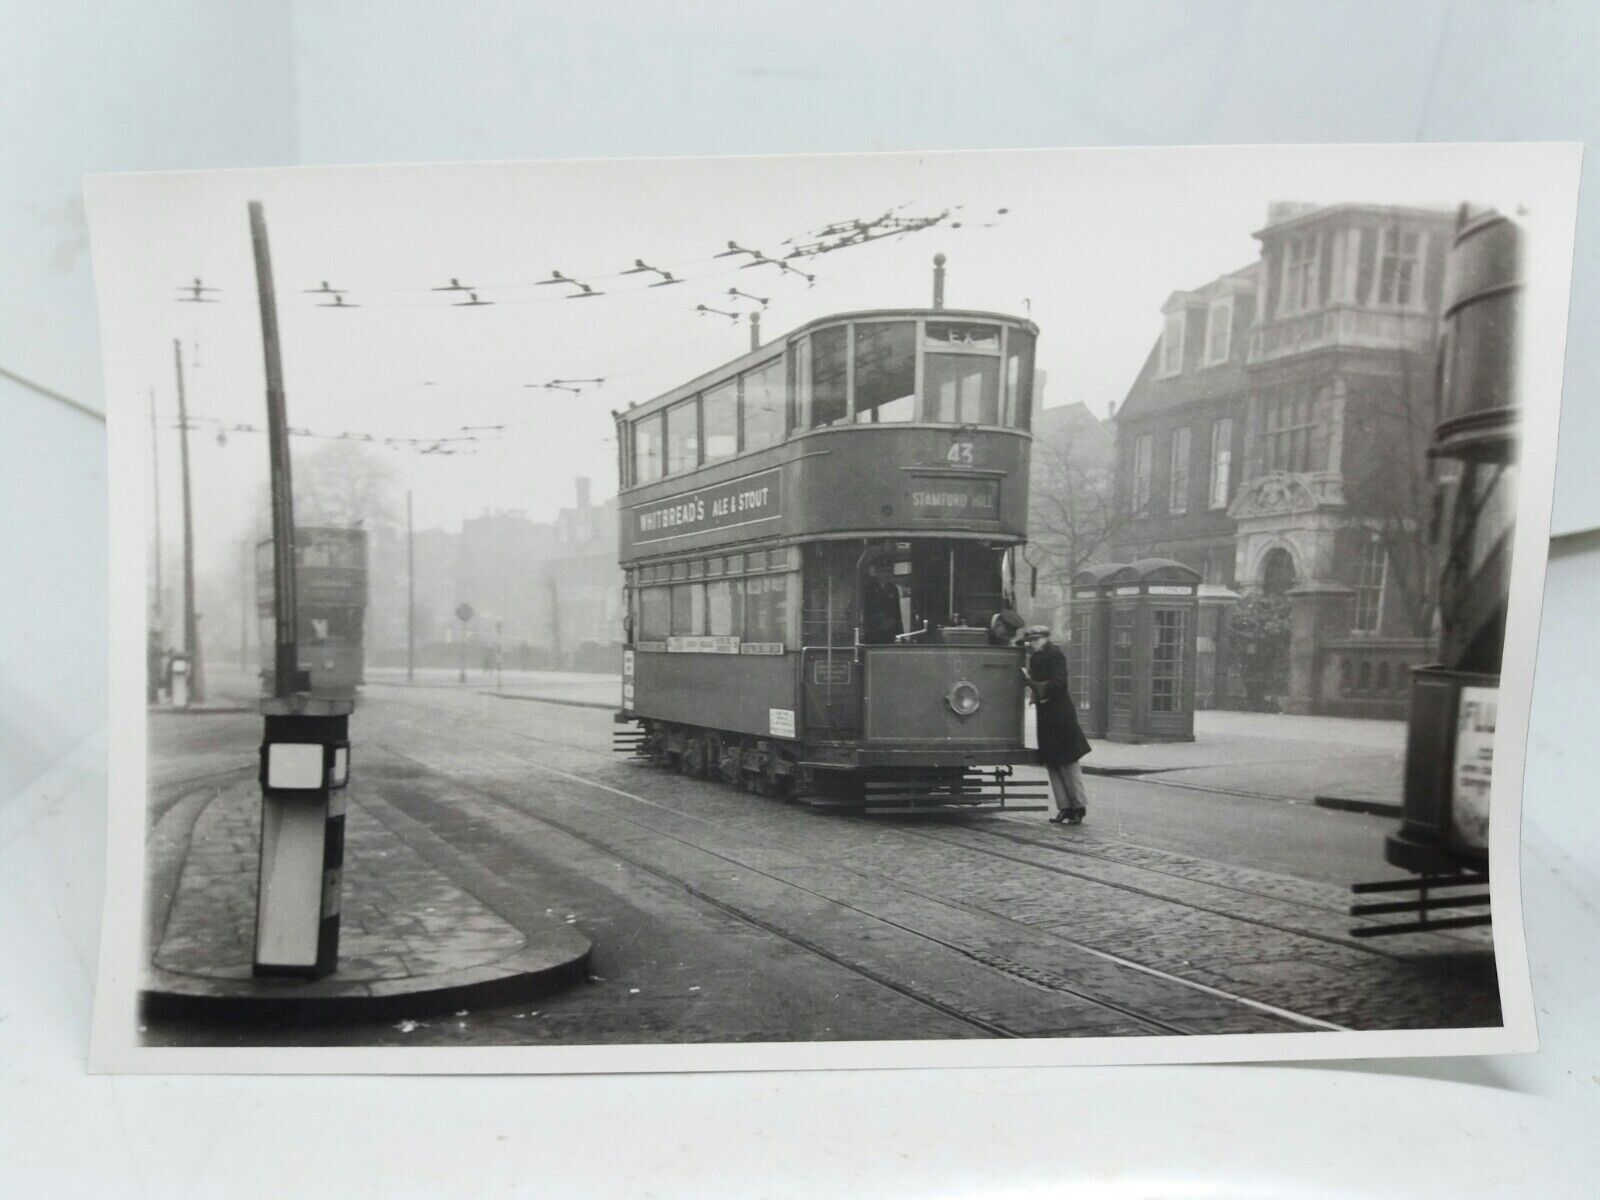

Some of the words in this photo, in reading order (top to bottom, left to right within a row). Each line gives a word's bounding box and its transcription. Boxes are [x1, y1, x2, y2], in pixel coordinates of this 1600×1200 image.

[947, 442, 974, 463] 43
[712, 497, 729, 517] ALE
[731, 495, 736, 513] &
[738, 487, 769, 512] STOUT
